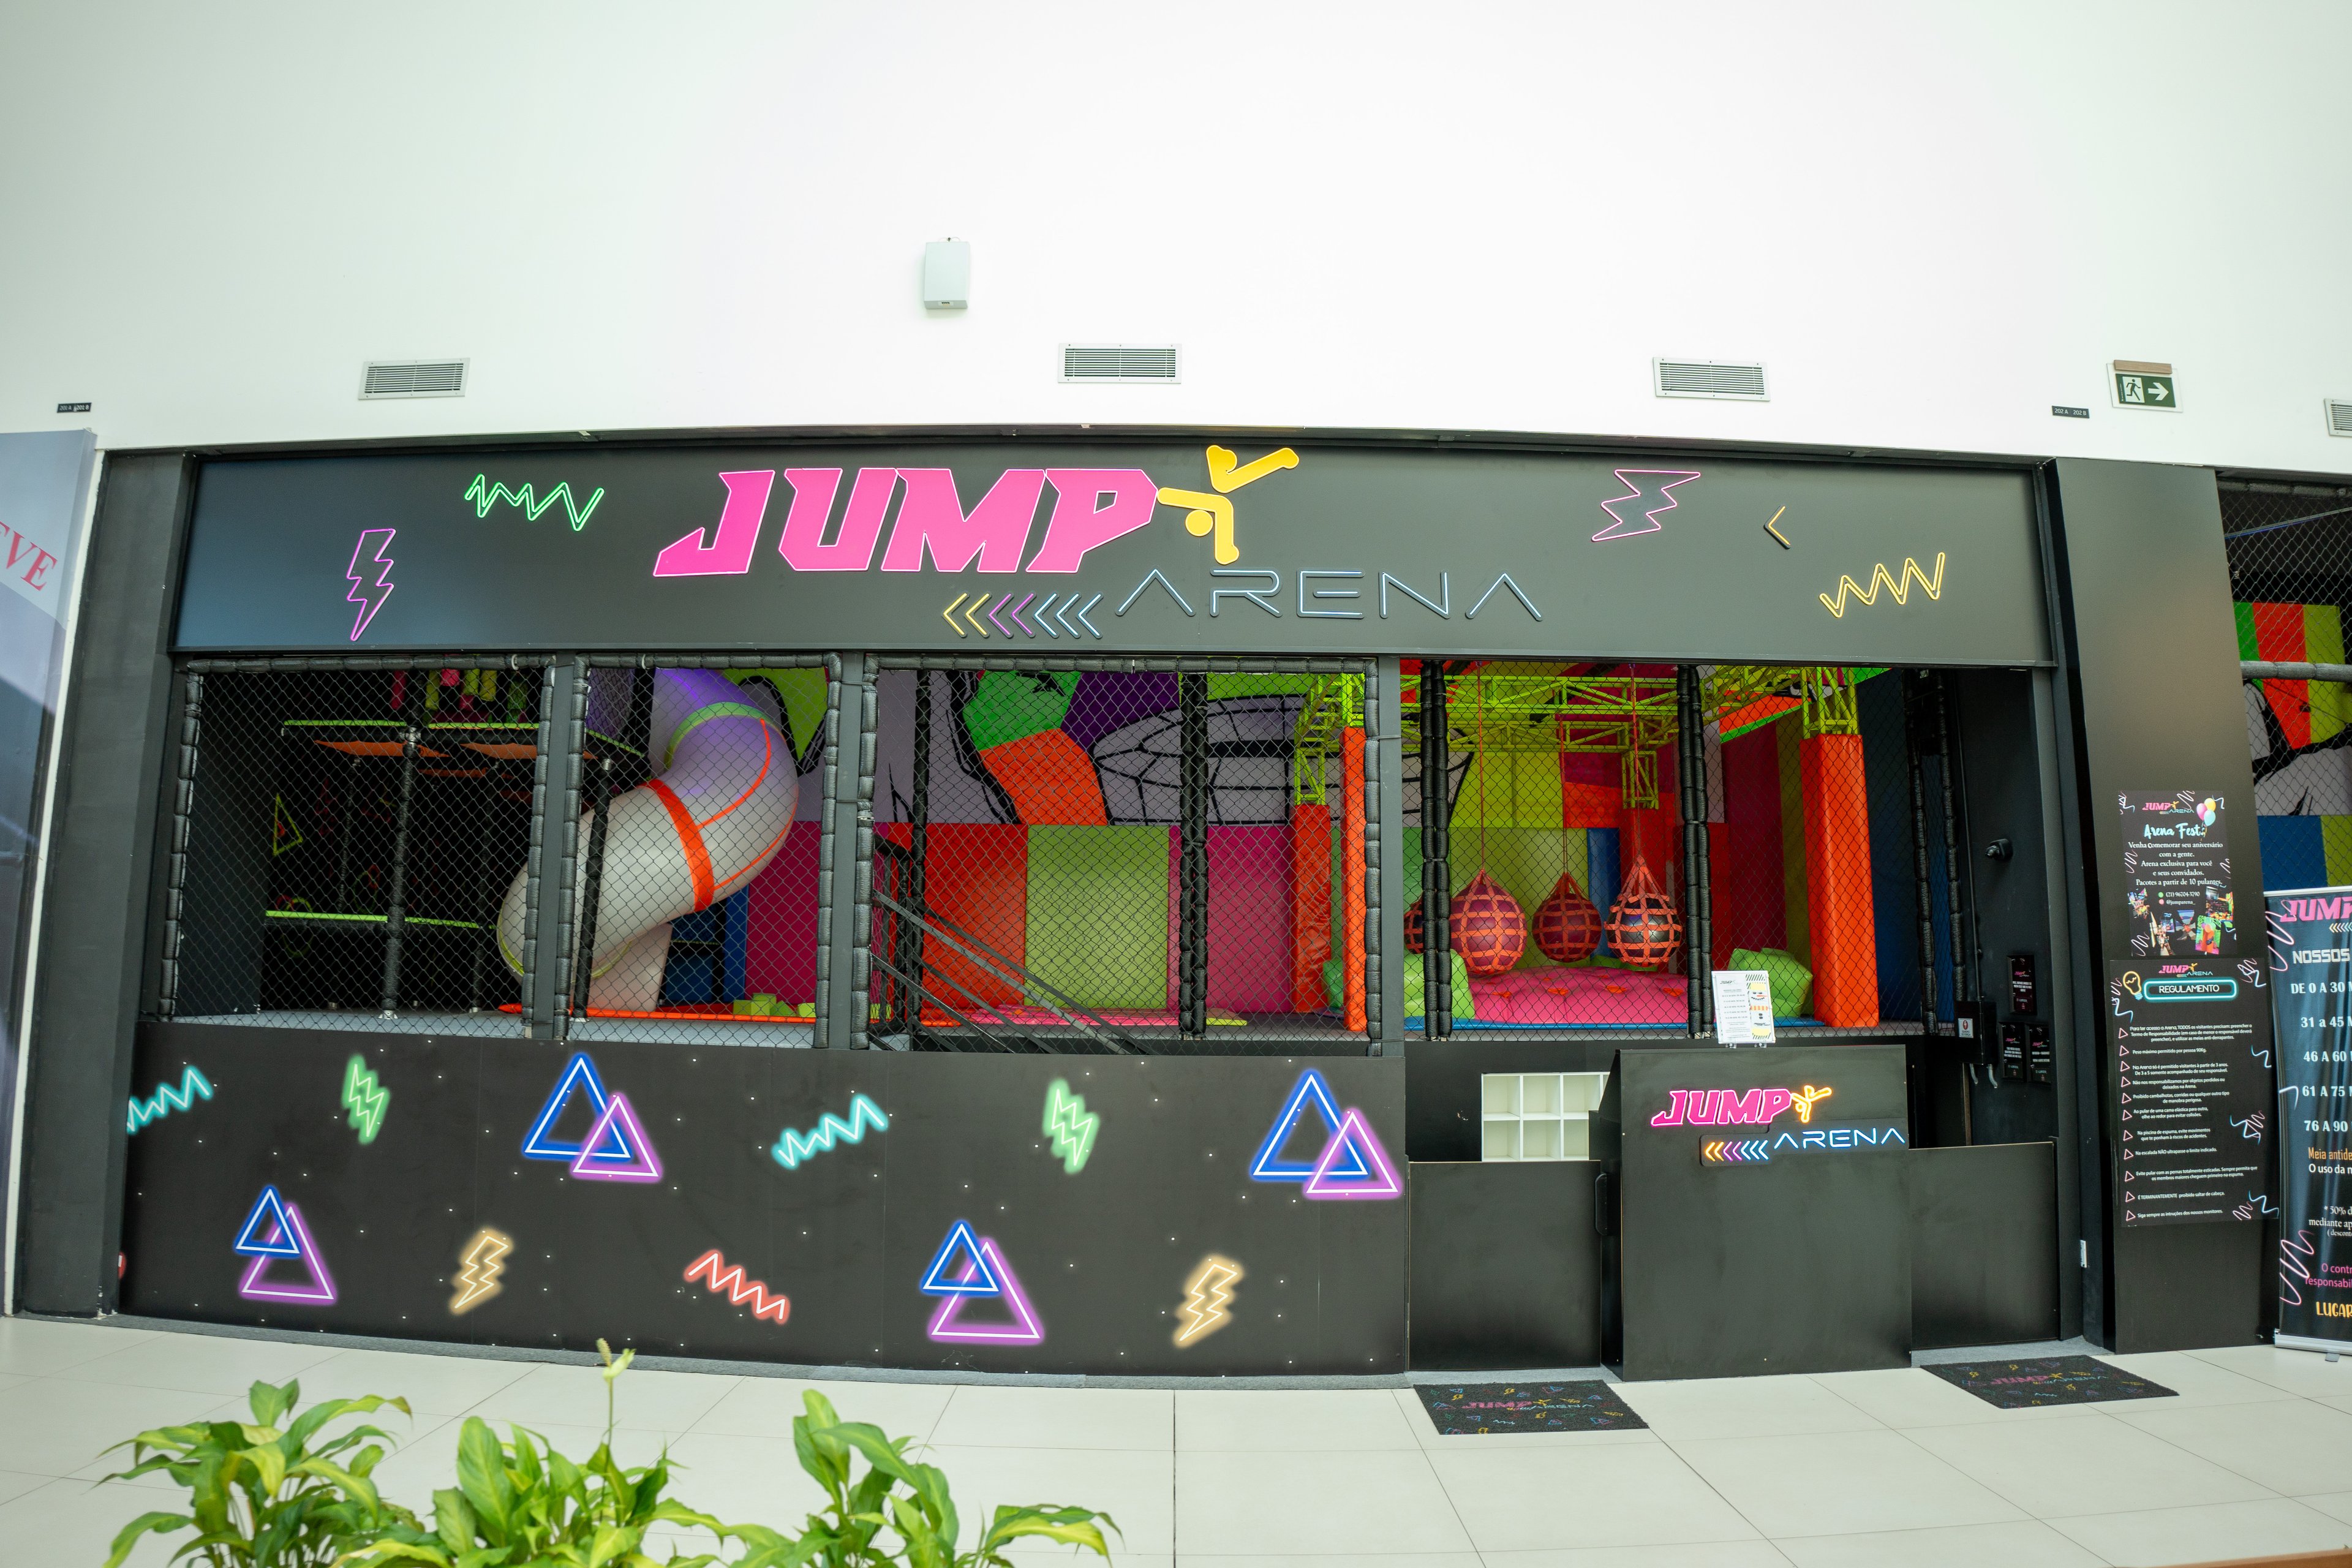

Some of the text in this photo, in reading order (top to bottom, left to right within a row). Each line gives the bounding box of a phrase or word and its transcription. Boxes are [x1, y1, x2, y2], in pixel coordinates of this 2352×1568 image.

[653, 467, 1159, 577] JUMP
[1115, 567, 1543, 620] ARENA
[2144, 824, 2175, 839] Arena
[2293, 949, 2350, 963] NOSSOS
[2158, 965, 2188, 973] JUMP
[2158, 984, 2220, 993] REGULAMENTO
[2291, 983, 2305, 993] DE
[2309, 982, 2316, 993] 0
[2320, 982, 2327, 993] A
[2330, 982, 2345, 992] 30
[2301, 1017, 2314, 1027] 31
[2329, 1016, 2344, 1027] 45
[2304, 1051, 2318, 1061] 46
[2321, 1051, 2329, 1061] A
[2332, 1051, 2346, 1061] 60
[2302, 1085, 2315, 1096] 61
[2320, 1086, 2328, 1096] A
[2331, 1086, 2345, 1096] 75
[1651, 1088, 1793, 1126] JUMP
[2304, 1120, 2320, 1131] 76
[2323, 1121, 2330, 1131] A
[2333, 1121, 2348, 1132] 90
[1774, 1128, 1905, 1149] ARENA
[2309, 1147, 2326, 1159] Meia
[2309, 1164, 2316, 1172] O
[2334, 1164, 2345, 1174] da
[2330, 1206, 2346, 1215] 50%
[2309, 1218, 2342, 1227] mediante
[2321, 1263, 2328, 1272] O
